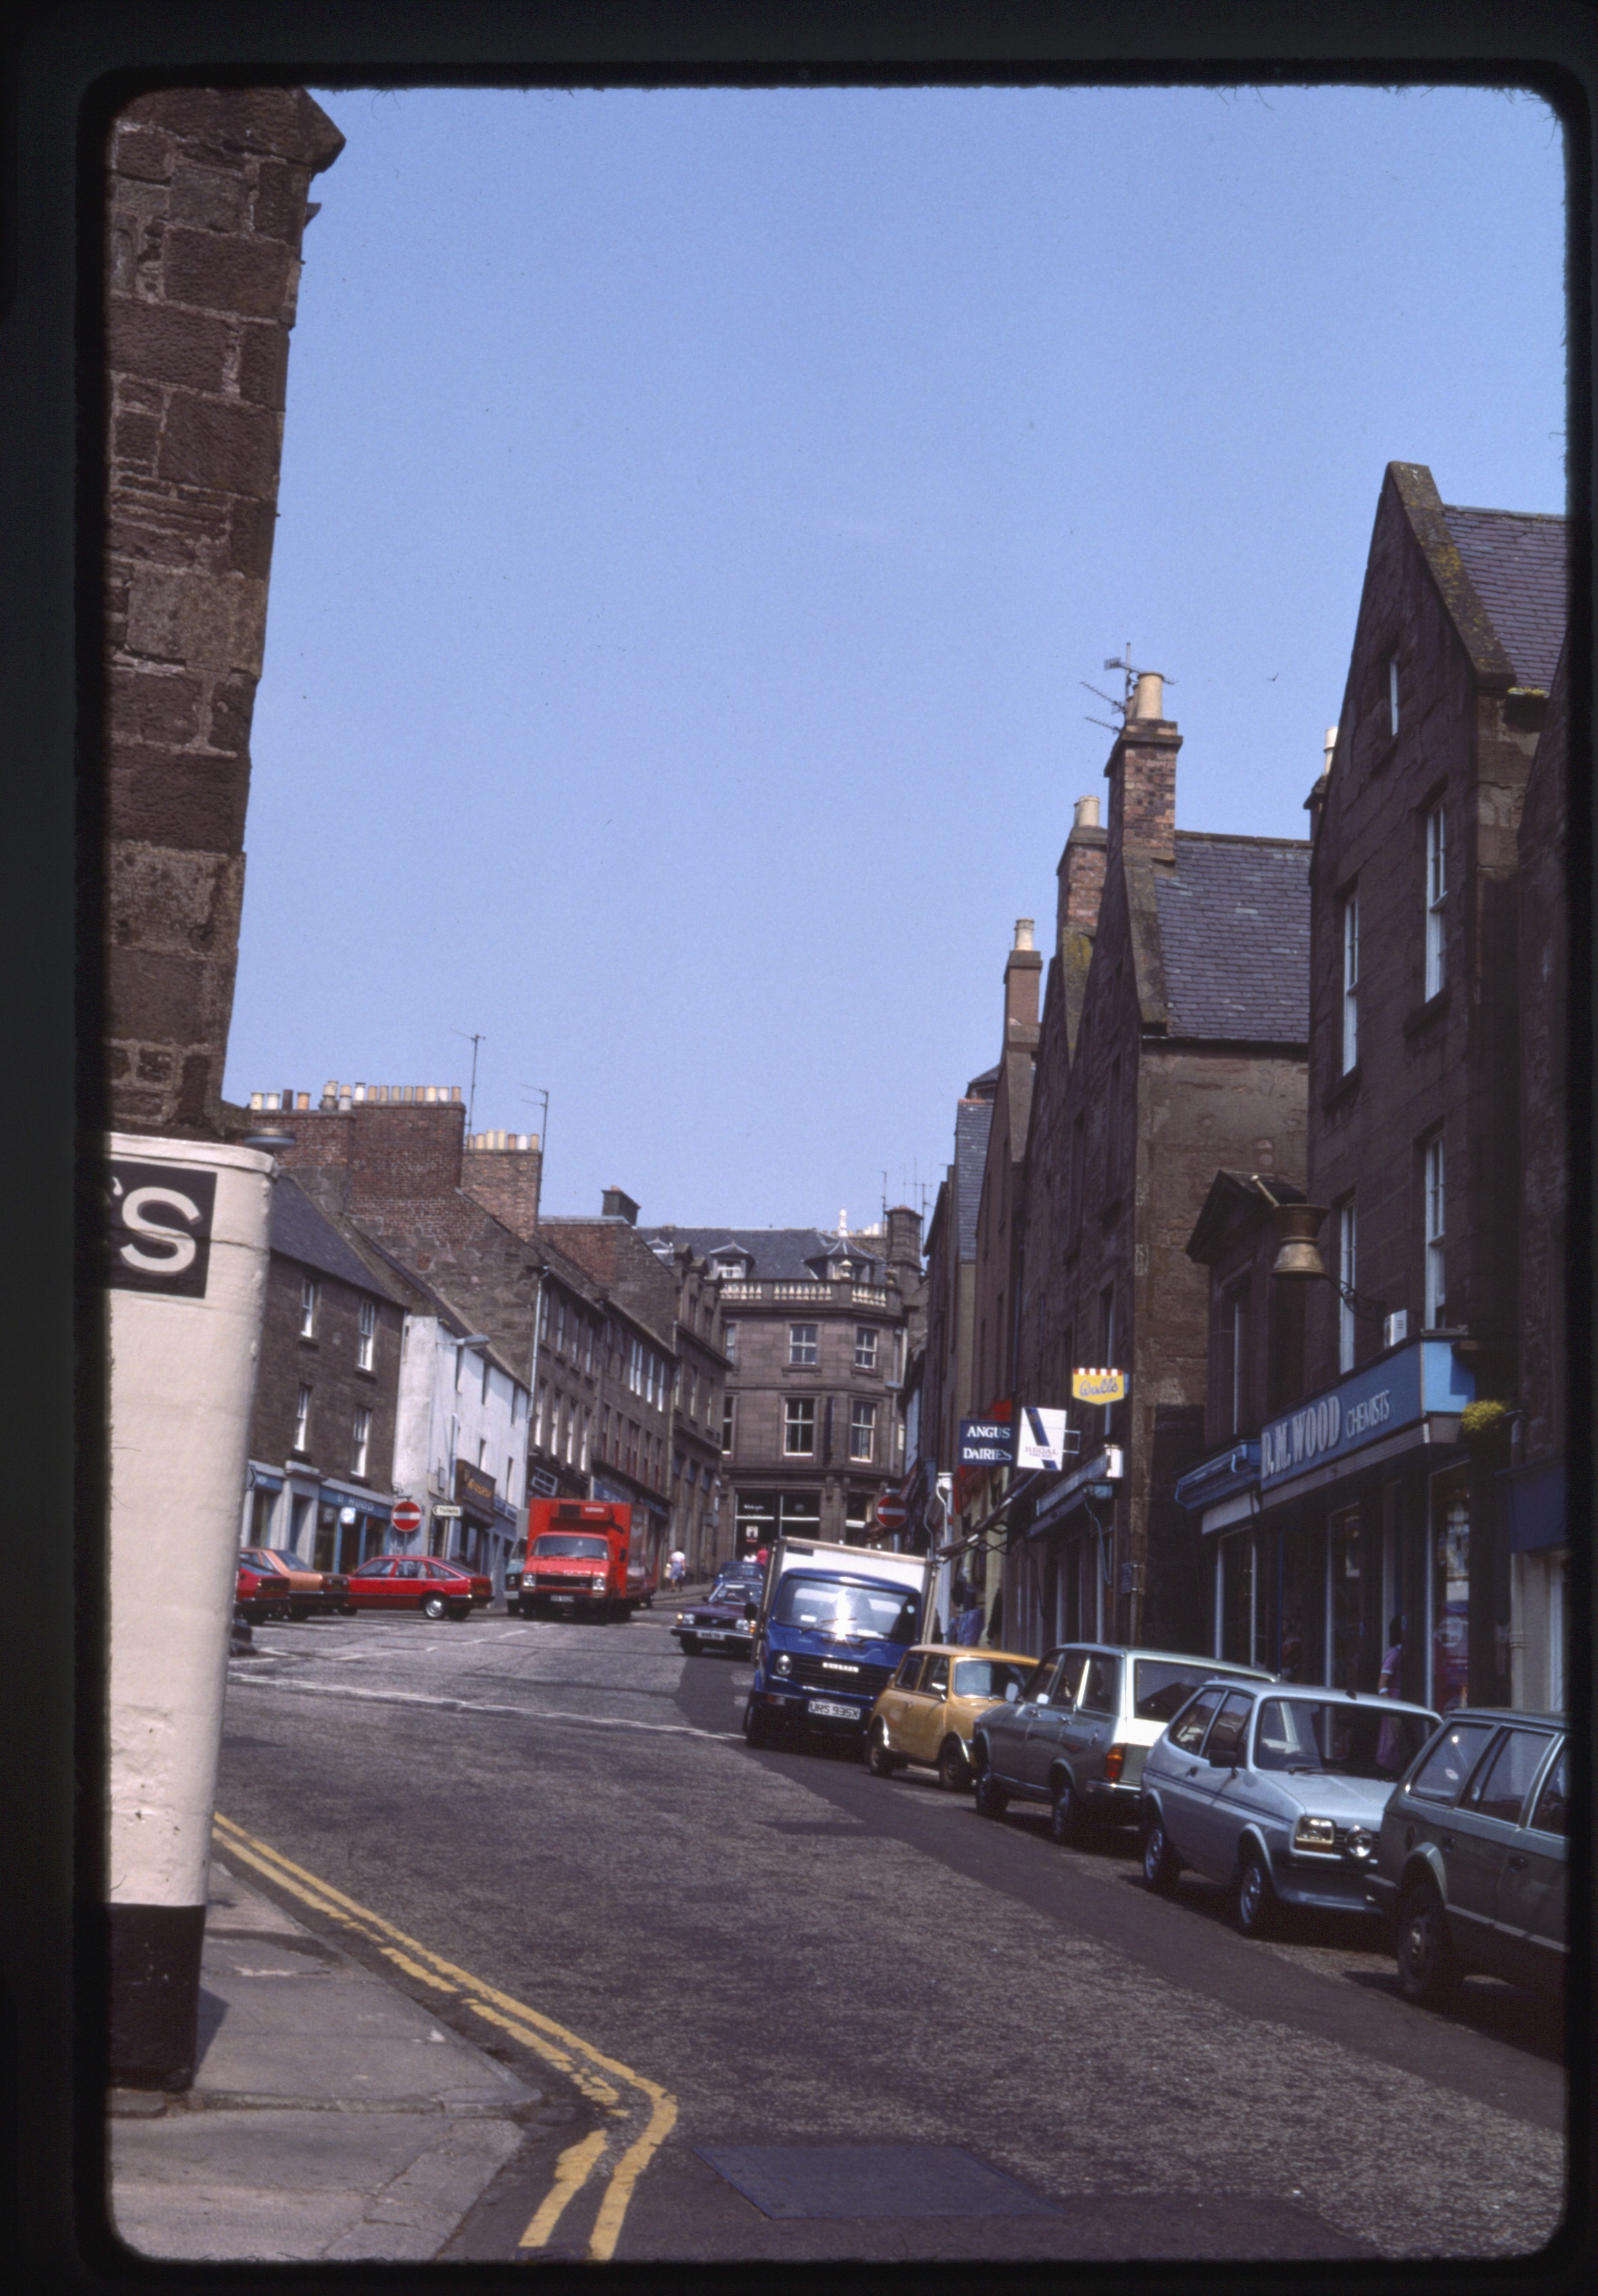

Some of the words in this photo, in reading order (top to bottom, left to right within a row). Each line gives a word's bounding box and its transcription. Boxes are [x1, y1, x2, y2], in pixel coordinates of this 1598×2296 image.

[1079, 1378, 1119, 1397] Wall's
[966, 1426, 1011, 1439] ANGUS
[1292, 1395, 1341, 1463] WOOD
[1345, 1389, 1390, 1439] CHEMISTS
[963, 1447, 1012, 1461] DAIRIES
[1024, 1446, 1058, 1455] REGAL
[348, 1497, 374, 1512] HOOD
